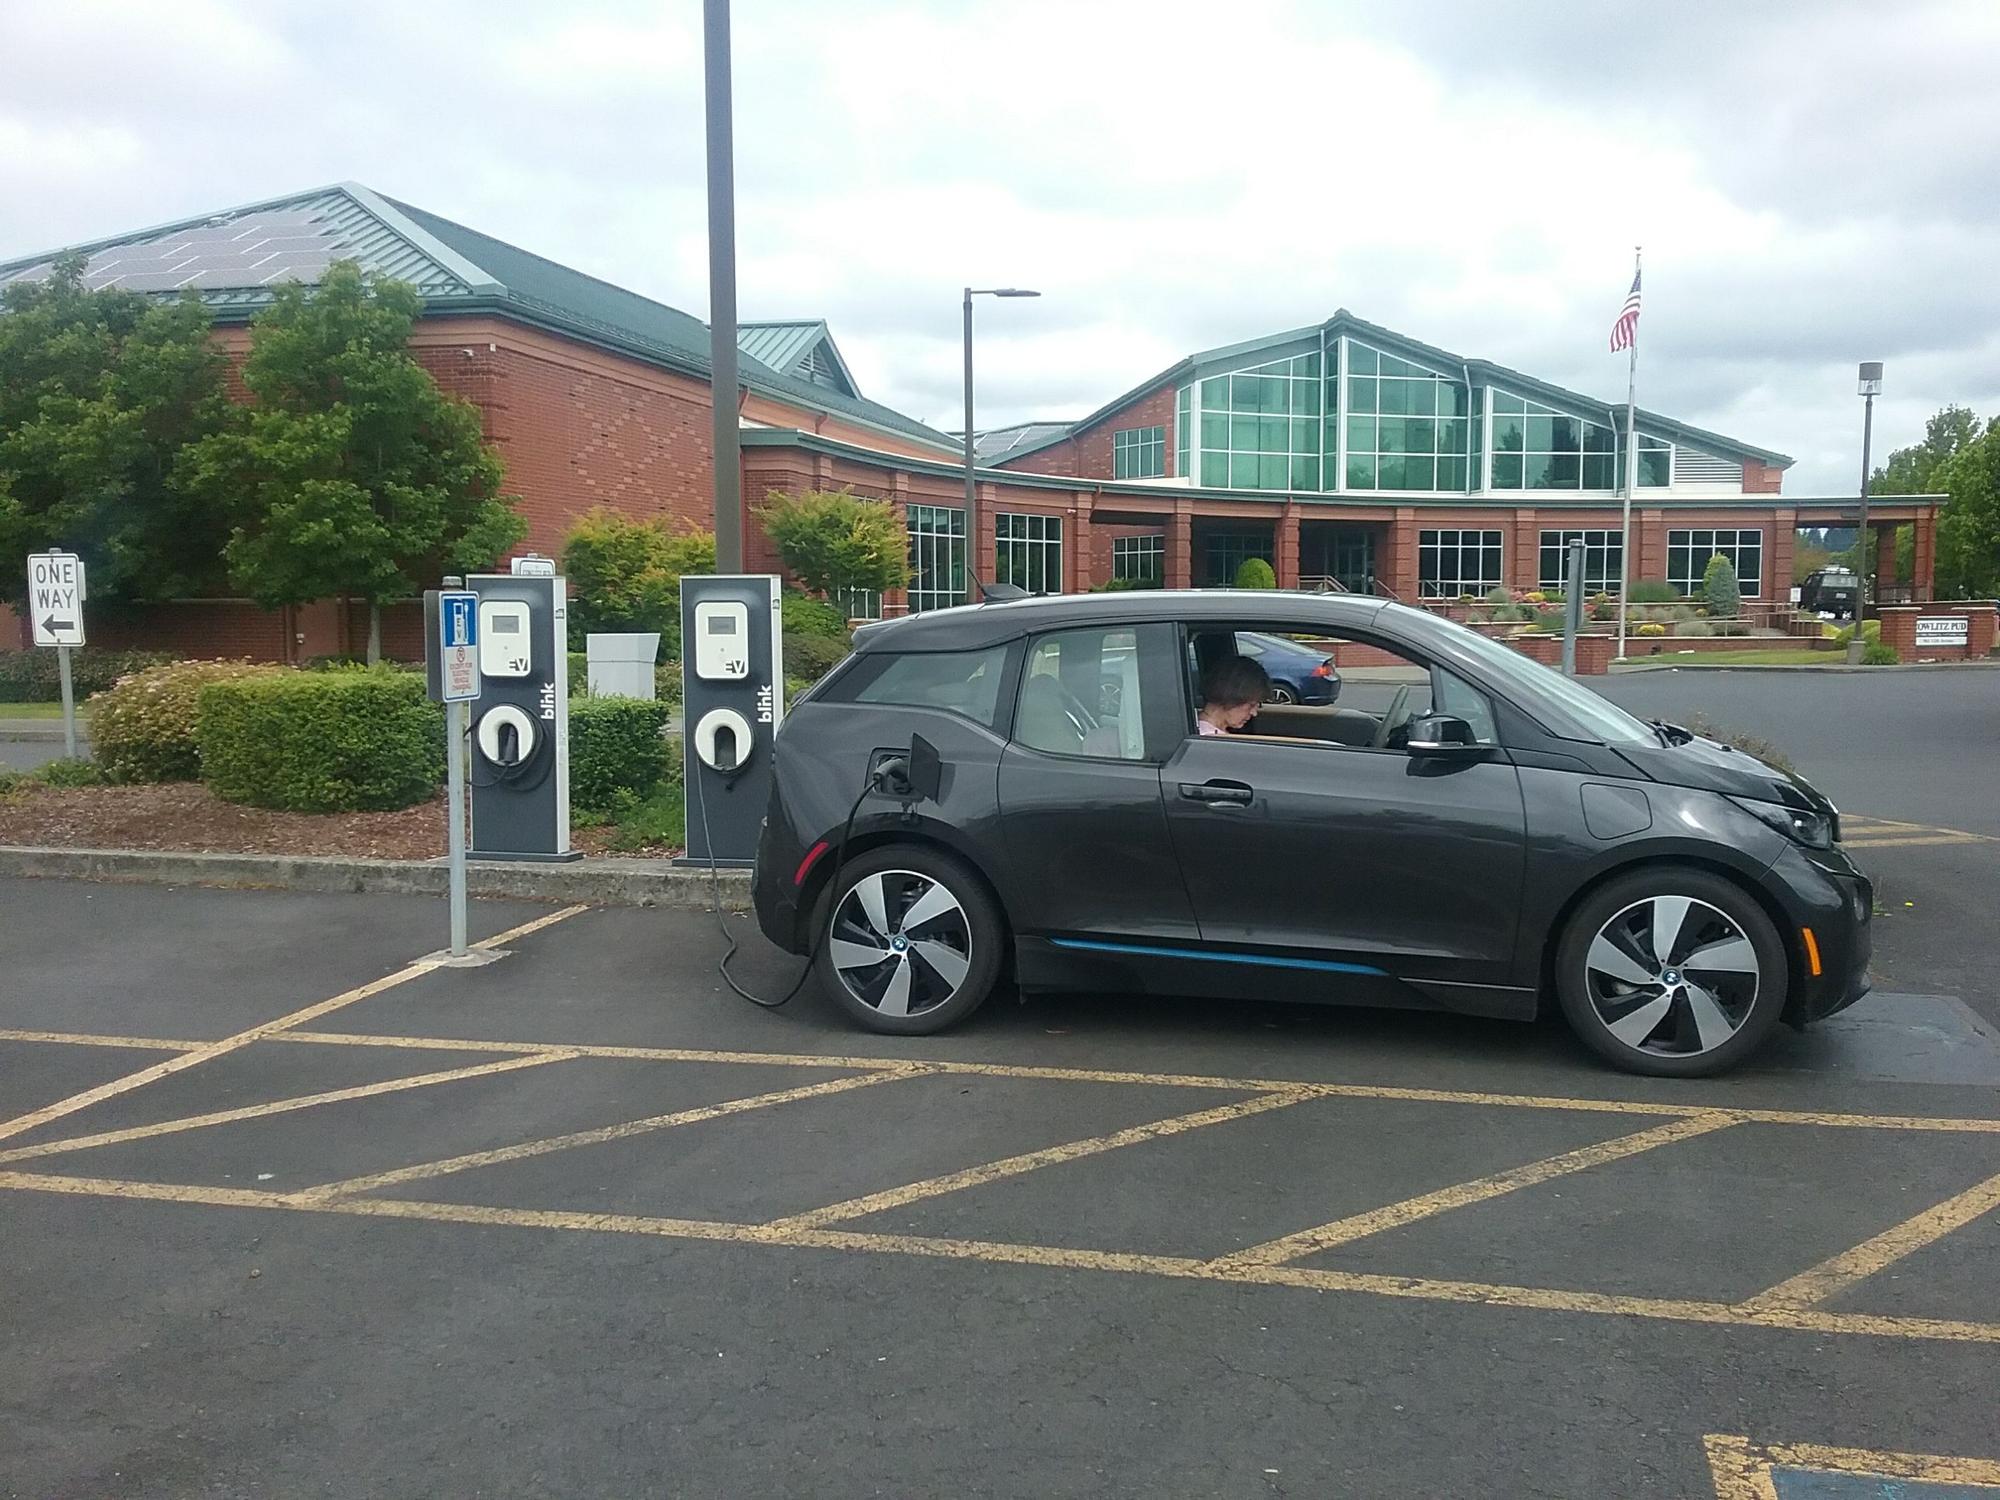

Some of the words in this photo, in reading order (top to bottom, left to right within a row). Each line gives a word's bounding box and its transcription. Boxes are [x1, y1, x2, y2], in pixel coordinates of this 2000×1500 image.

[36, 563, 73, 584] ONE
[37, 588, 74, 609] WAY
[1951, 622, 1967, 631] PUD
[509, 658, 528, 672] EV
[725, 660, 745, 674] EV
[540, 682, 555, 720] blink
[757, 684, 772, 723] blink
